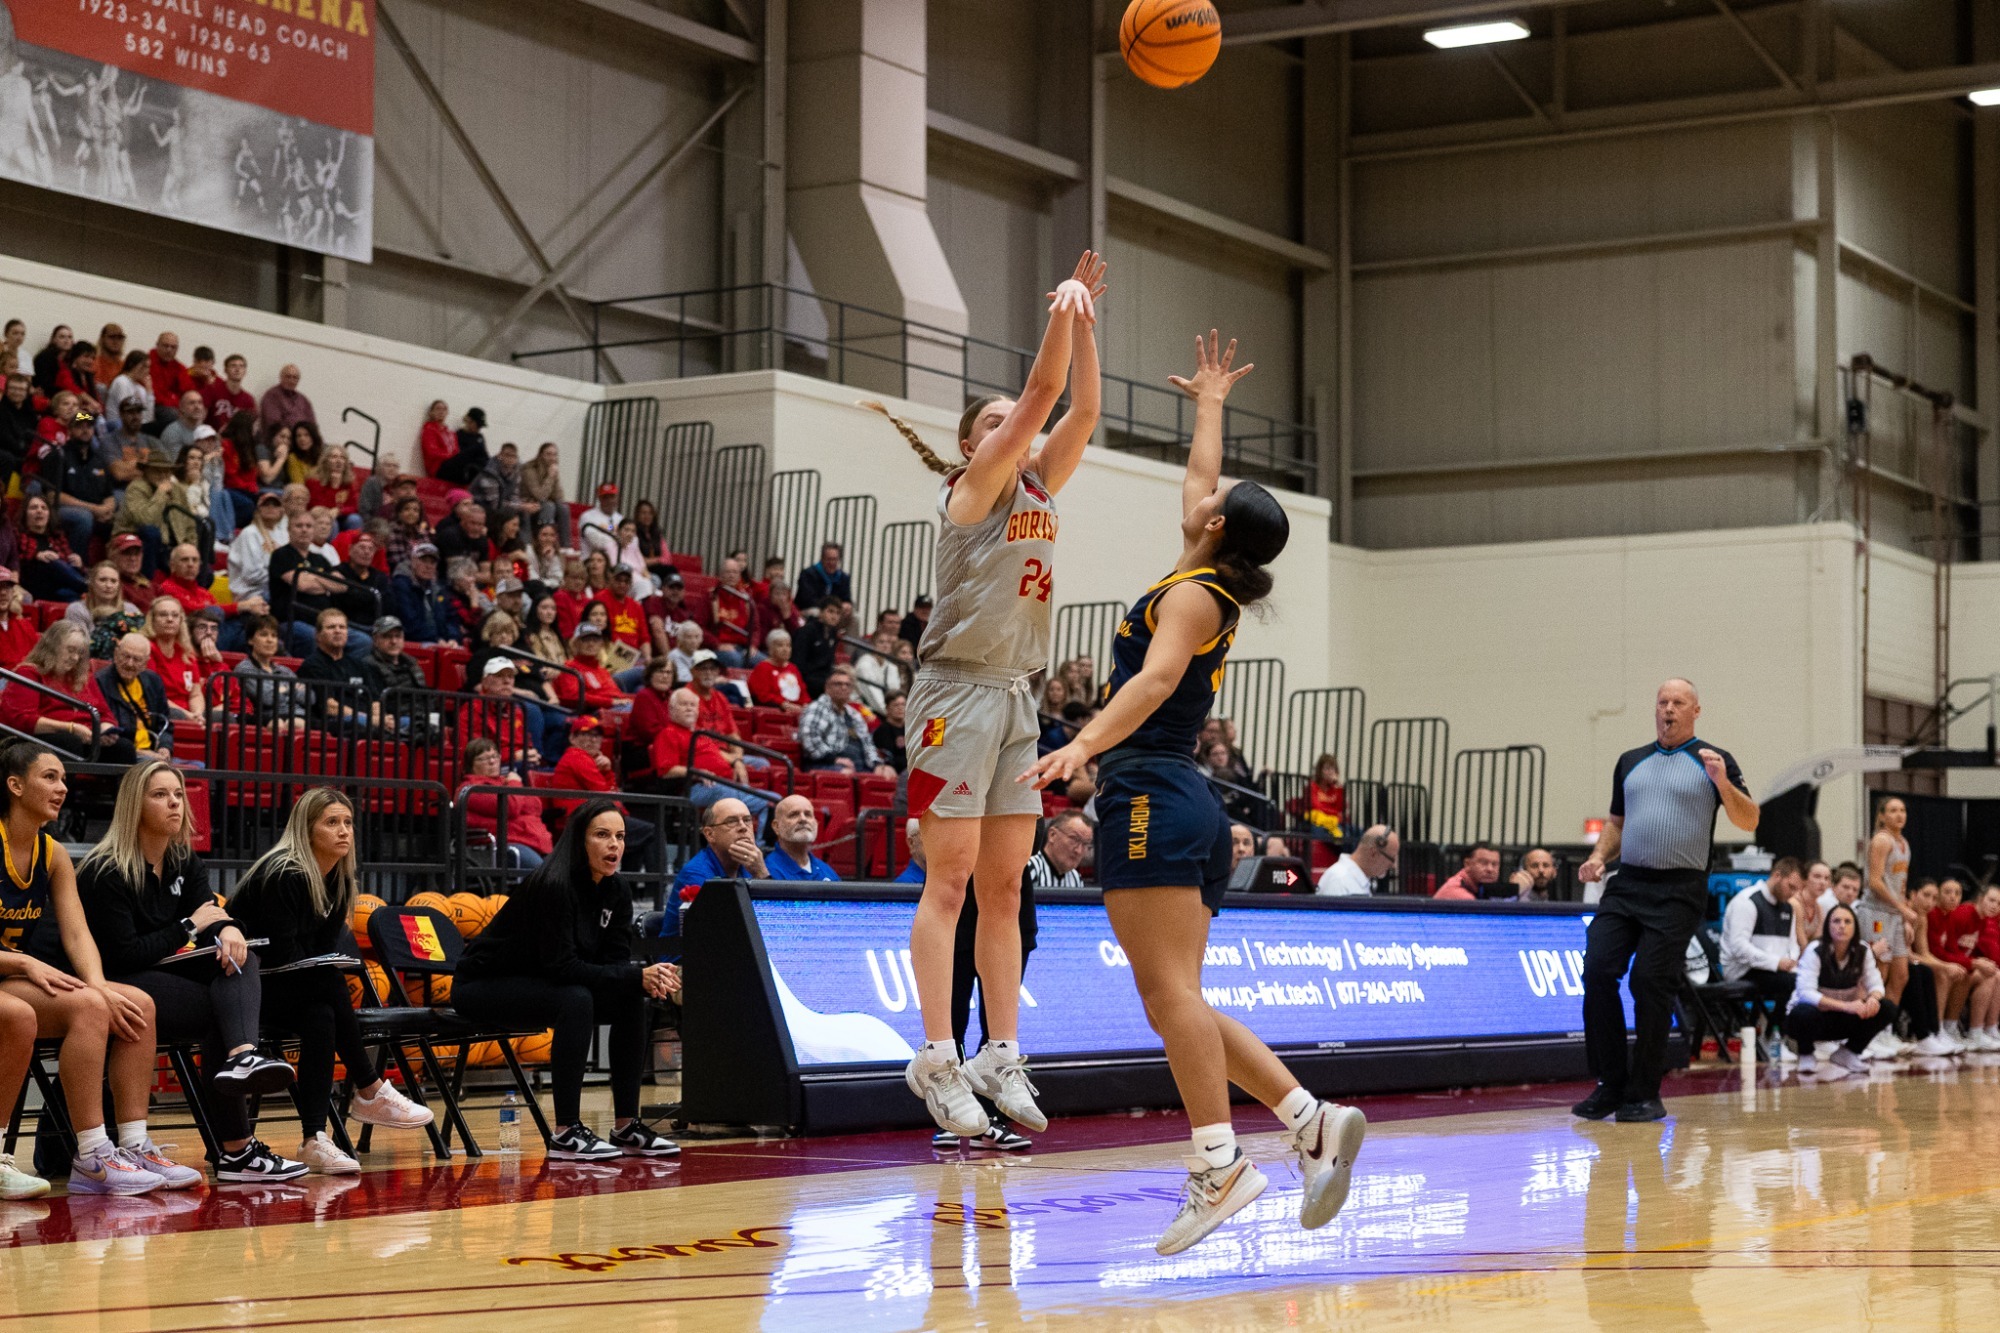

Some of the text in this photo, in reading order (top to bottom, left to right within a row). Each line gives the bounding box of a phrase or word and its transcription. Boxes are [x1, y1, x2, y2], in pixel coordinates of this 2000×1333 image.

[212, 4, 267, 36] HEAD
[276, 24, 349, 61] COACH
[245, 0, 369, 37] ENA
[125, 32, 228, 77] 582 WINS
[189, 23, 271, 64] 1936-63
[1018, 558, 1053, 603] 24
[1129, 794, 1150, 860] OKLAHOMA
[0, 898, 43, 921] roncho
[1254, 941, 1343, 971] Technology
[1355, 942, 1413, 971] Security
